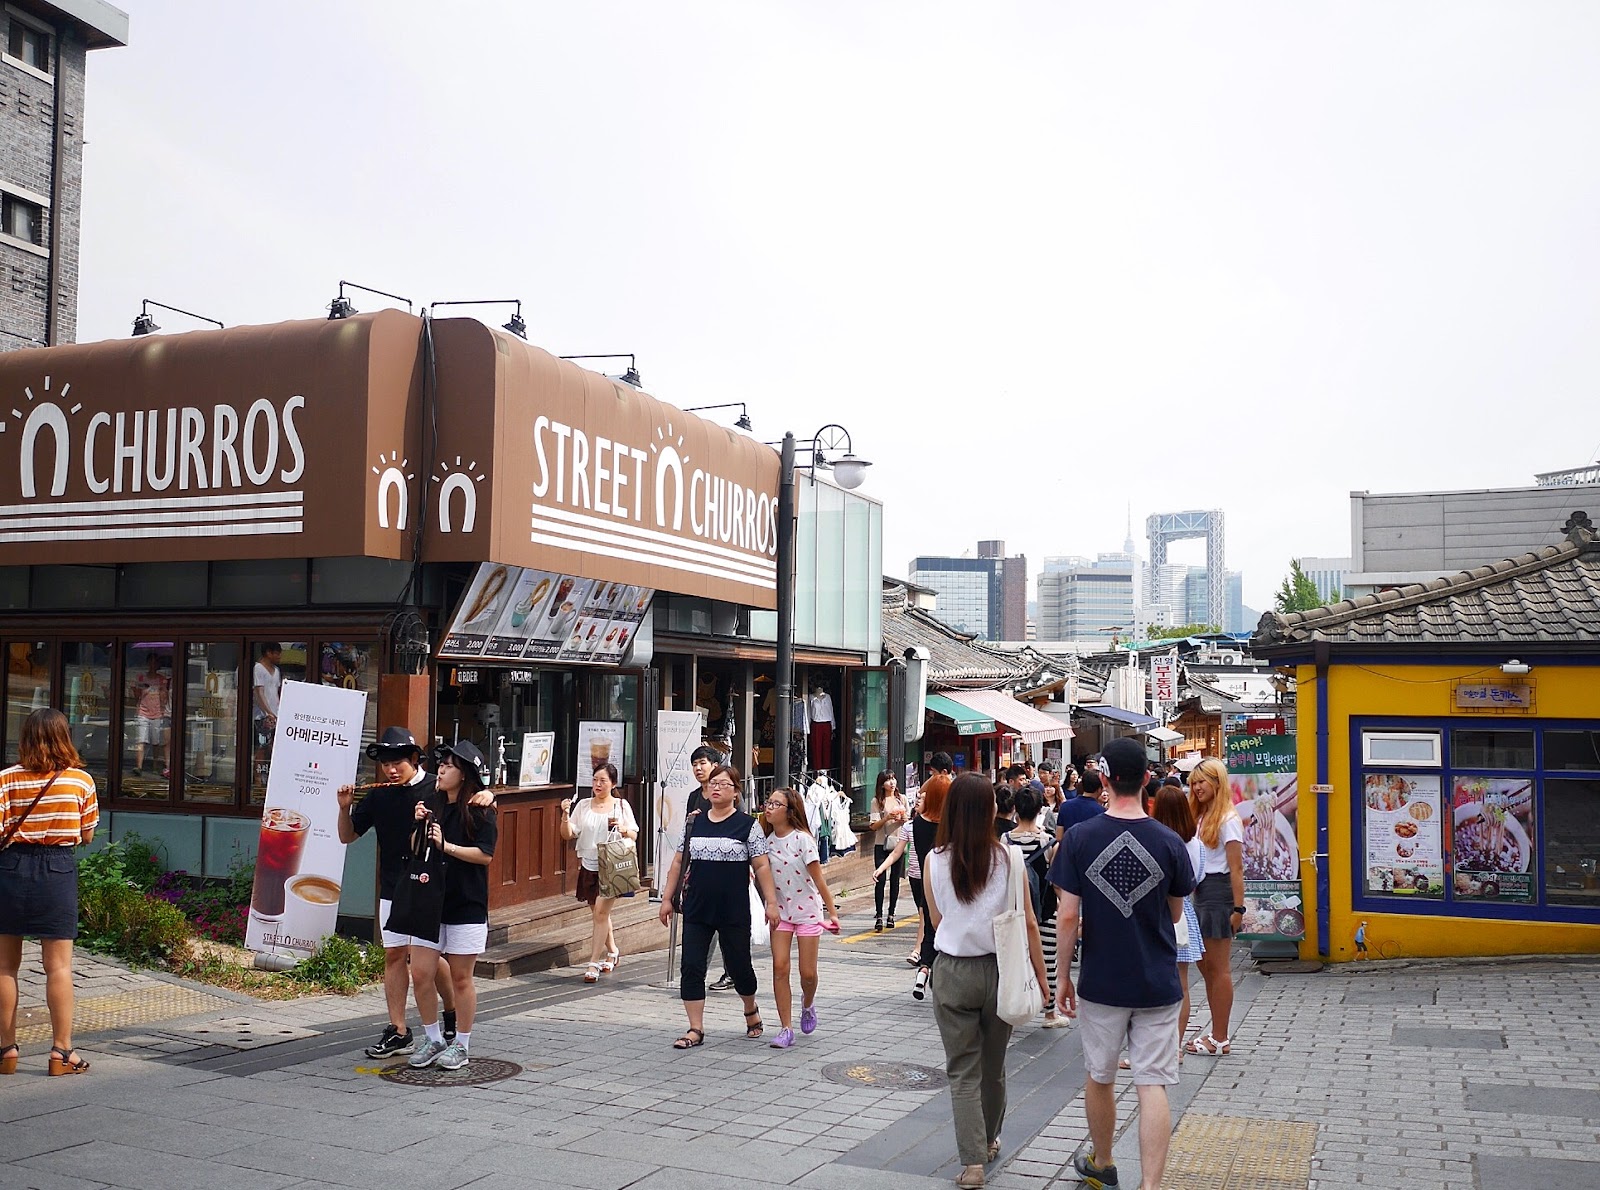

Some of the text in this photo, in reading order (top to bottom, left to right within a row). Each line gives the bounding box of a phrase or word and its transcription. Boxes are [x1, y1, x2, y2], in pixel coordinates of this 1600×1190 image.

[84, 395, 305, 495] CHURROS
[532, 415, 778, 556] STREET CHURROS
[466, 640, 483, 649] 2,000
[507, 643, 524, 652] 3,000
[457, 670, 478, 683] ORDER
[1155, 665, 1172, 701] 부동산
[286, 726, 349, 747] 아메리카노
[299, 785, 321, 796] 2,000
[615, 860, 633, 870] LOTTE
